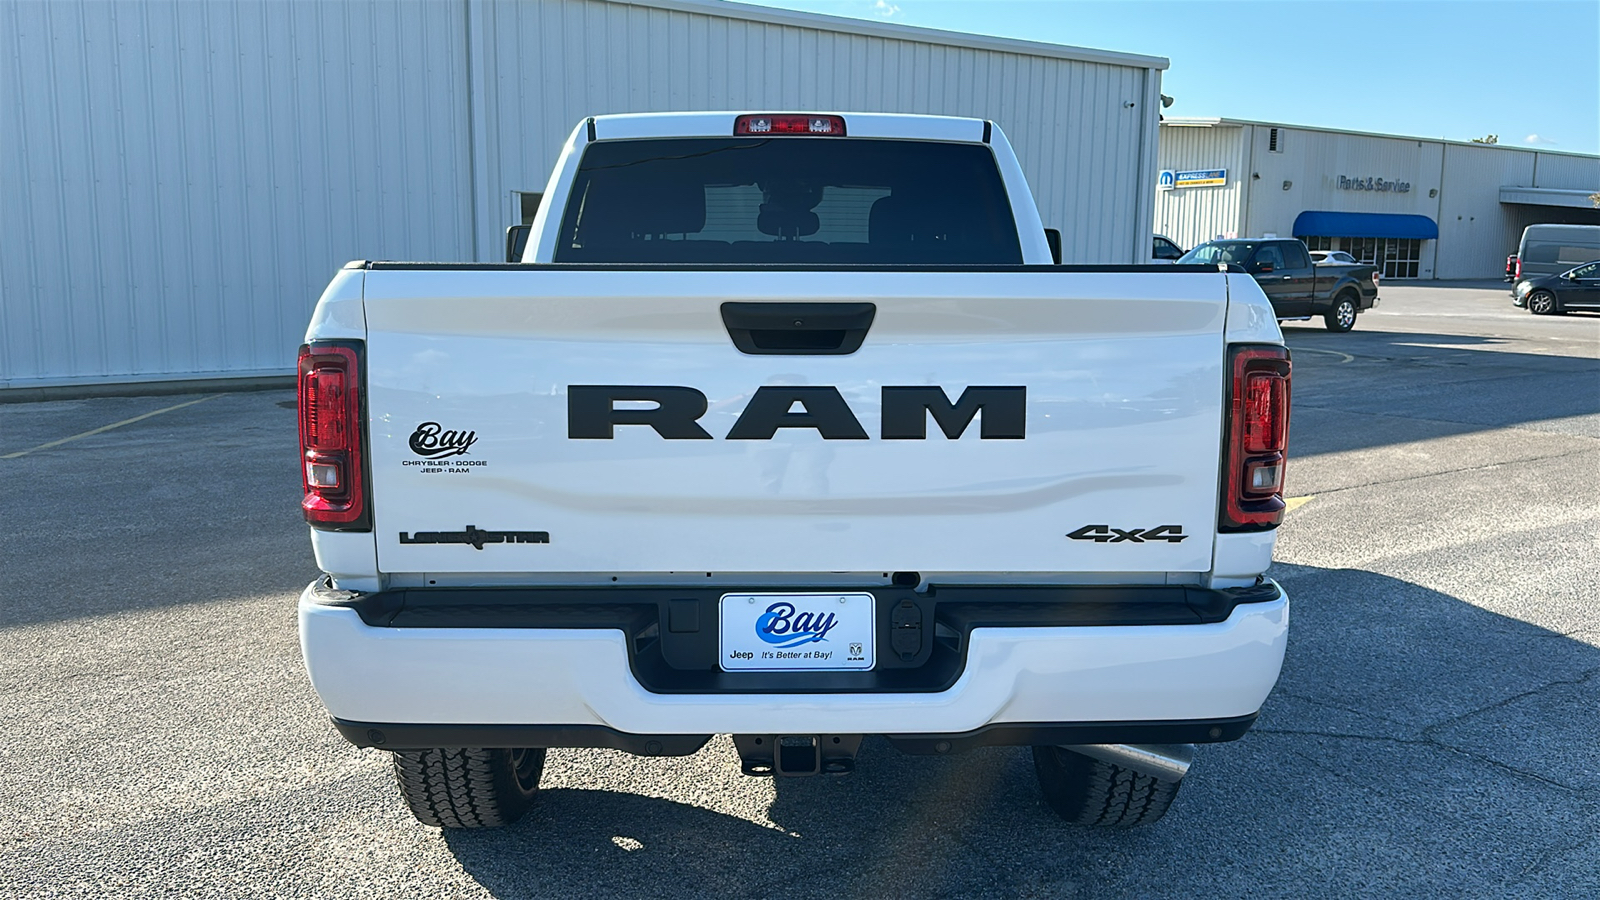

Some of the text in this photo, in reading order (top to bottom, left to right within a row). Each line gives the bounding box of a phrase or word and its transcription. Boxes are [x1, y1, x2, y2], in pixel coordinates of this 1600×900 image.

[1337, 175, 1410, 193] Parts & Service
[568, 385, 1026, 439] RAM
[412, 422, 478, 455] Bay
[1065, 524, 1189, 543] 4x4
[762, 602, 839, 643] Bay
[729, 650, 754, 660] Jeep
[761, 651, 833, 660] It's Better at Bay!
